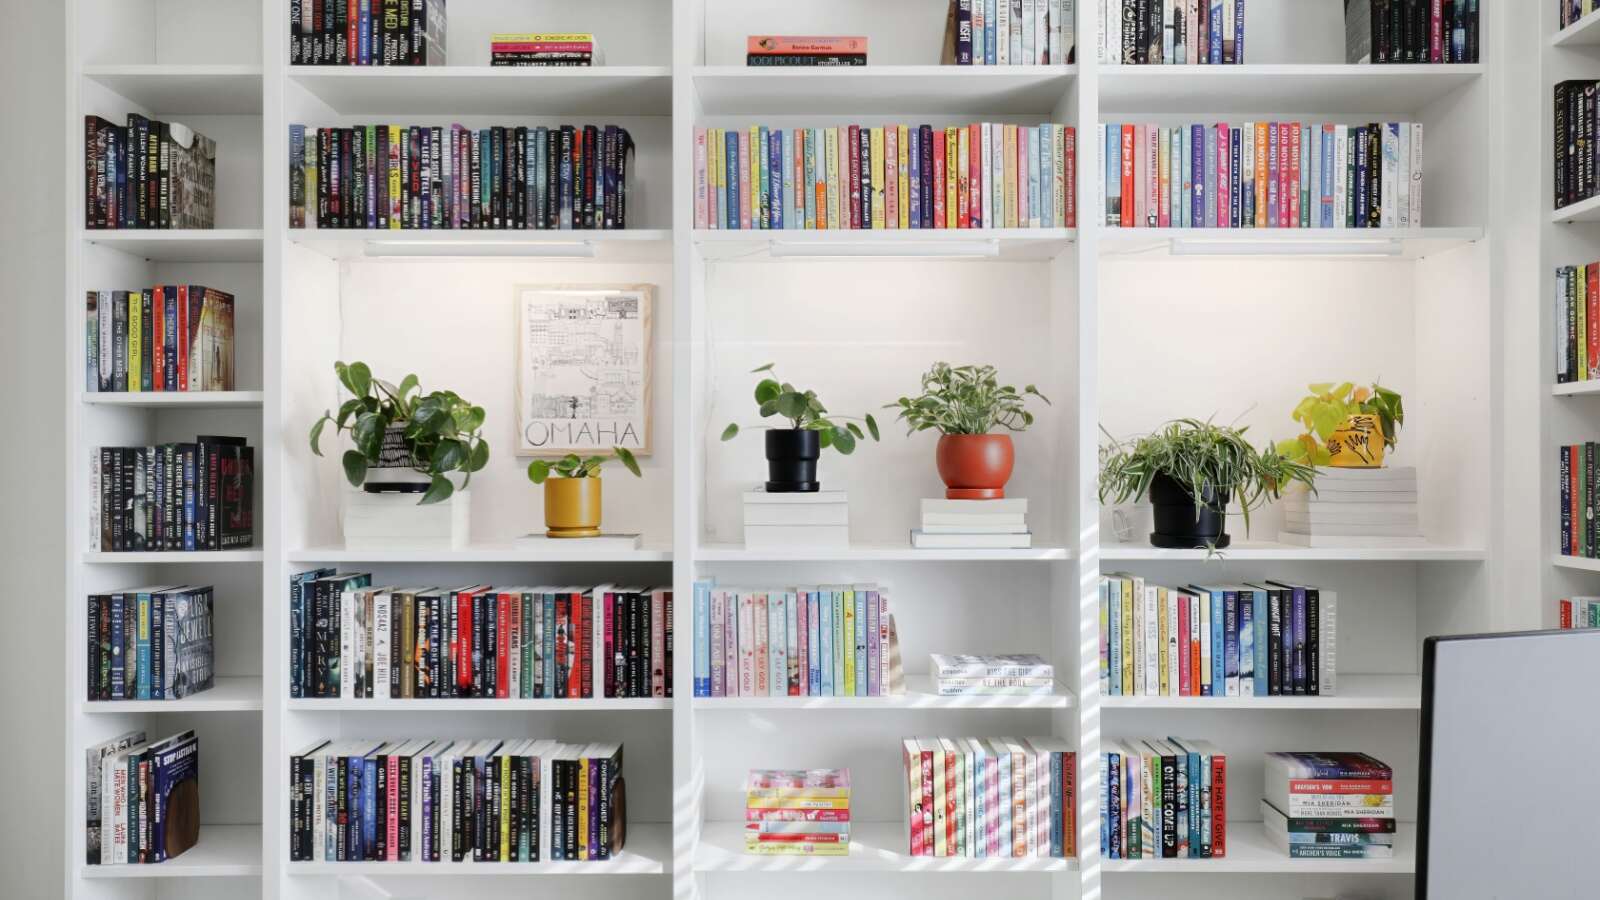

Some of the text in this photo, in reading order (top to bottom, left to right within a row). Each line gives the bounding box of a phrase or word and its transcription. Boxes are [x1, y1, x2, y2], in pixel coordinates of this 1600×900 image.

[1557, 111, 1565, 158] SCHWAB
[88, 140, 96, 170] WIVES
[525, 421, 640, 446] OMAHA
[1165, 767, 1173, 846] ON THE COME UP
[1330, 834, 1358, 843] TRAVIS
